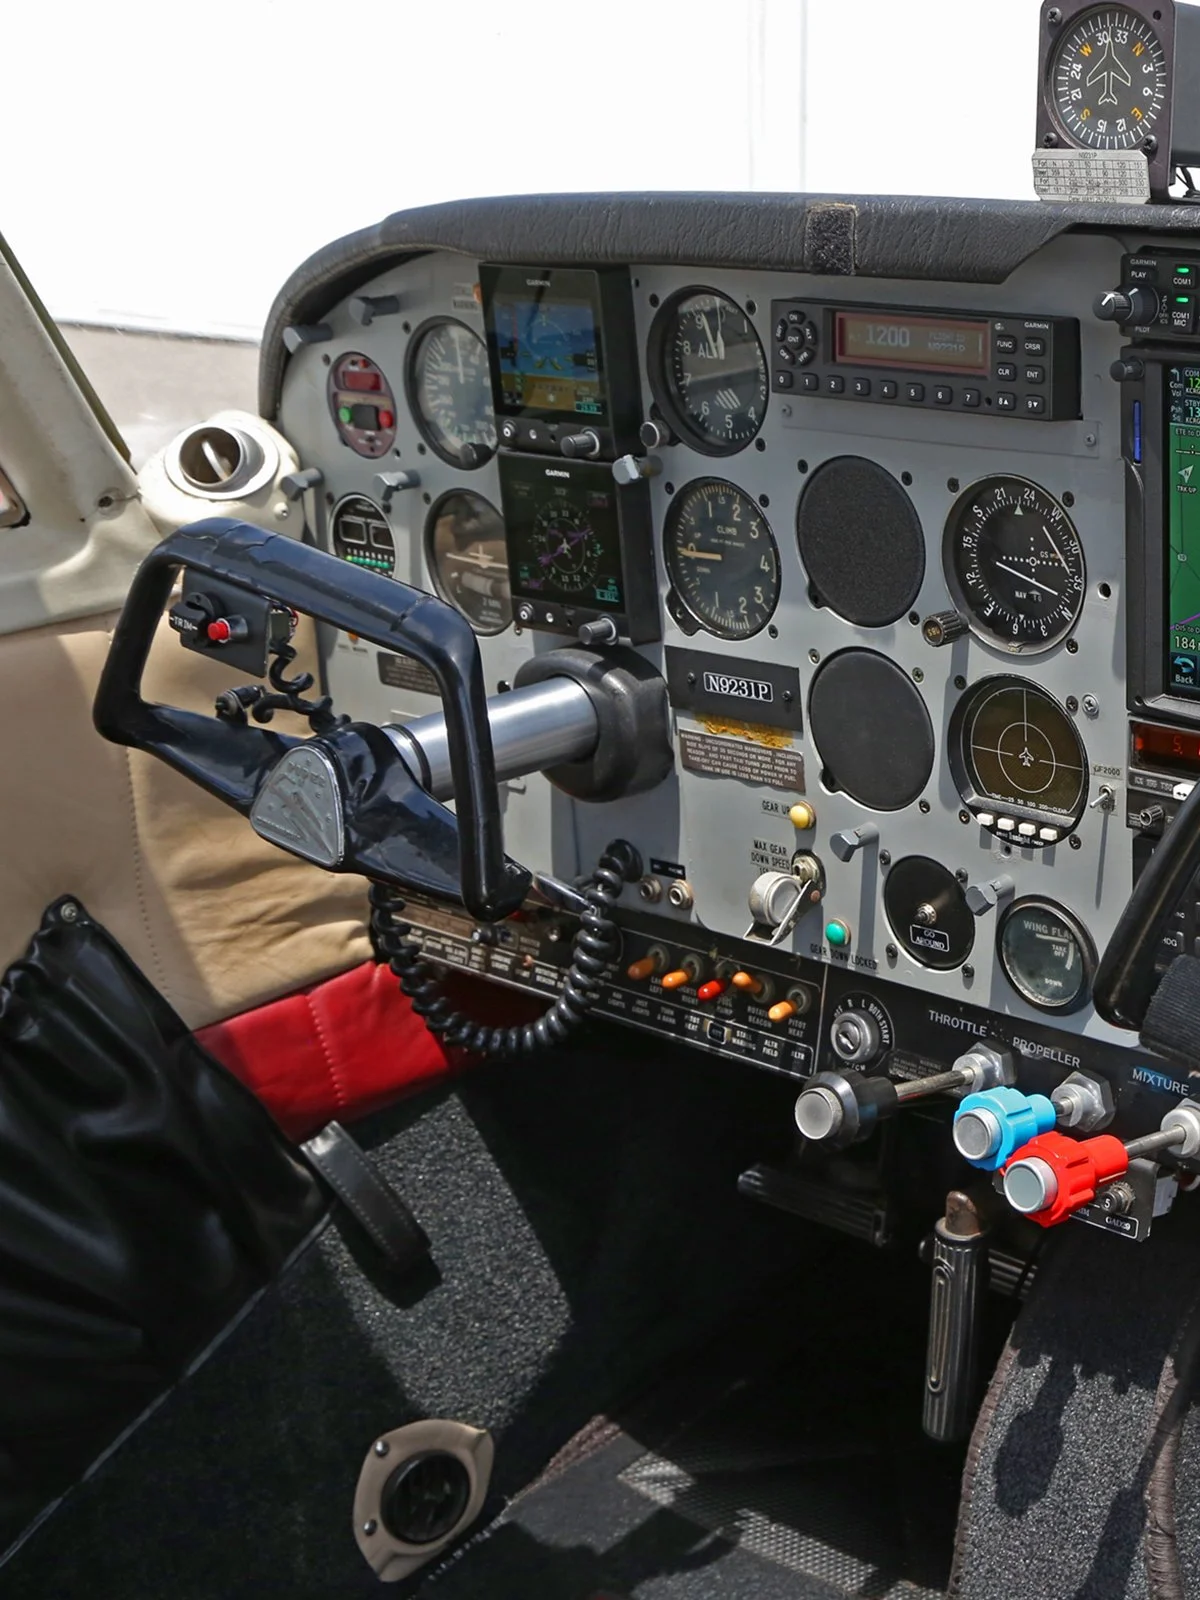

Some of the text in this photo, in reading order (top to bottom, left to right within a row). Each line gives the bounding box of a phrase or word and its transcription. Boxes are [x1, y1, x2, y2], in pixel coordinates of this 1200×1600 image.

[1114, 31, 1128, 44] 33
[1080, 44, 1093, 57] W
[1132, 43, 1144, 56] N
[1071, 64, 1082, 79] 24
[1131, 271, 1147, 279] PLAY
[1173, 277, 1191, 286] COM1
[1025, 321, 1049, 329] GARMIN
[866, 324, 910, 347] 1200
[998, 368, 1010, 376] CLR
[725, 415, 733, 428] 5
[995, 487, 1006, 500] 21
[1024, 488, 1036, 501] 24
[732, 504, 741, 521] 2
[972, 505, 983, 517] S
[716, 525, 738, 536] CLIMB
[760, 555, 770, 572] 4
[174, 617, 193, 631] TRIM
[1175, 675, 1194, 685] Back
[708, 675, 769, 699] N9231P
[762, 801, 779, 813] GEAR
[751, 852, 790, 870] DOWN SPEED
[1023, 920, 1048, 935] WING
[915, 936, 945, 950] AROUND
[851, 955, 878, 970] LOCKED
[868, 1003, 882, 1022] BOTH
[928, 1009, 988, 1037] THROTTLE
[1012, 1036, 1081, 1068] PROPELLER
[1132, 1067, 1190, 1096] MIXTURE
